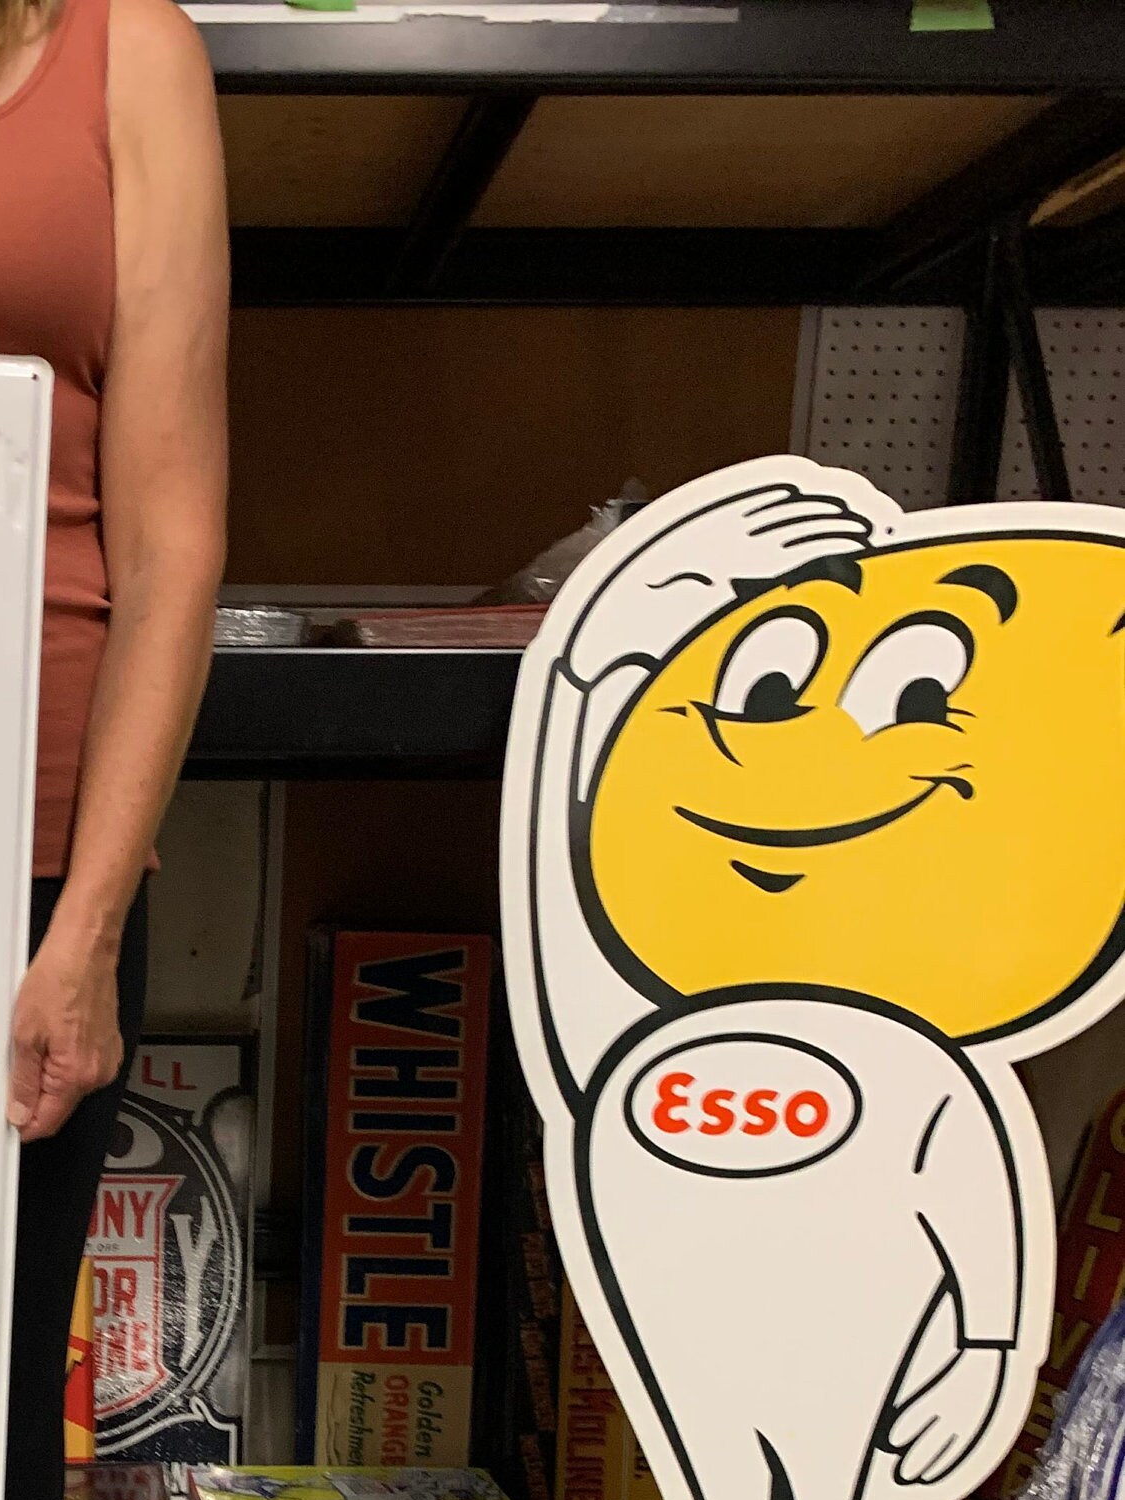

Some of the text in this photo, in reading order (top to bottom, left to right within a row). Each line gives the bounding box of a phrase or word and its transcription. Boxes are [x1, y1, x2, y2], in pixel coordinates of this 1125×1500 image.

[337, 946, 468, 1351] WHISTLE
[347, 1370, 377, 1467] Refreshmen
[381, 1375, 409, 1467] ORANGE
[415, 1380, 444, 1458] Golden
